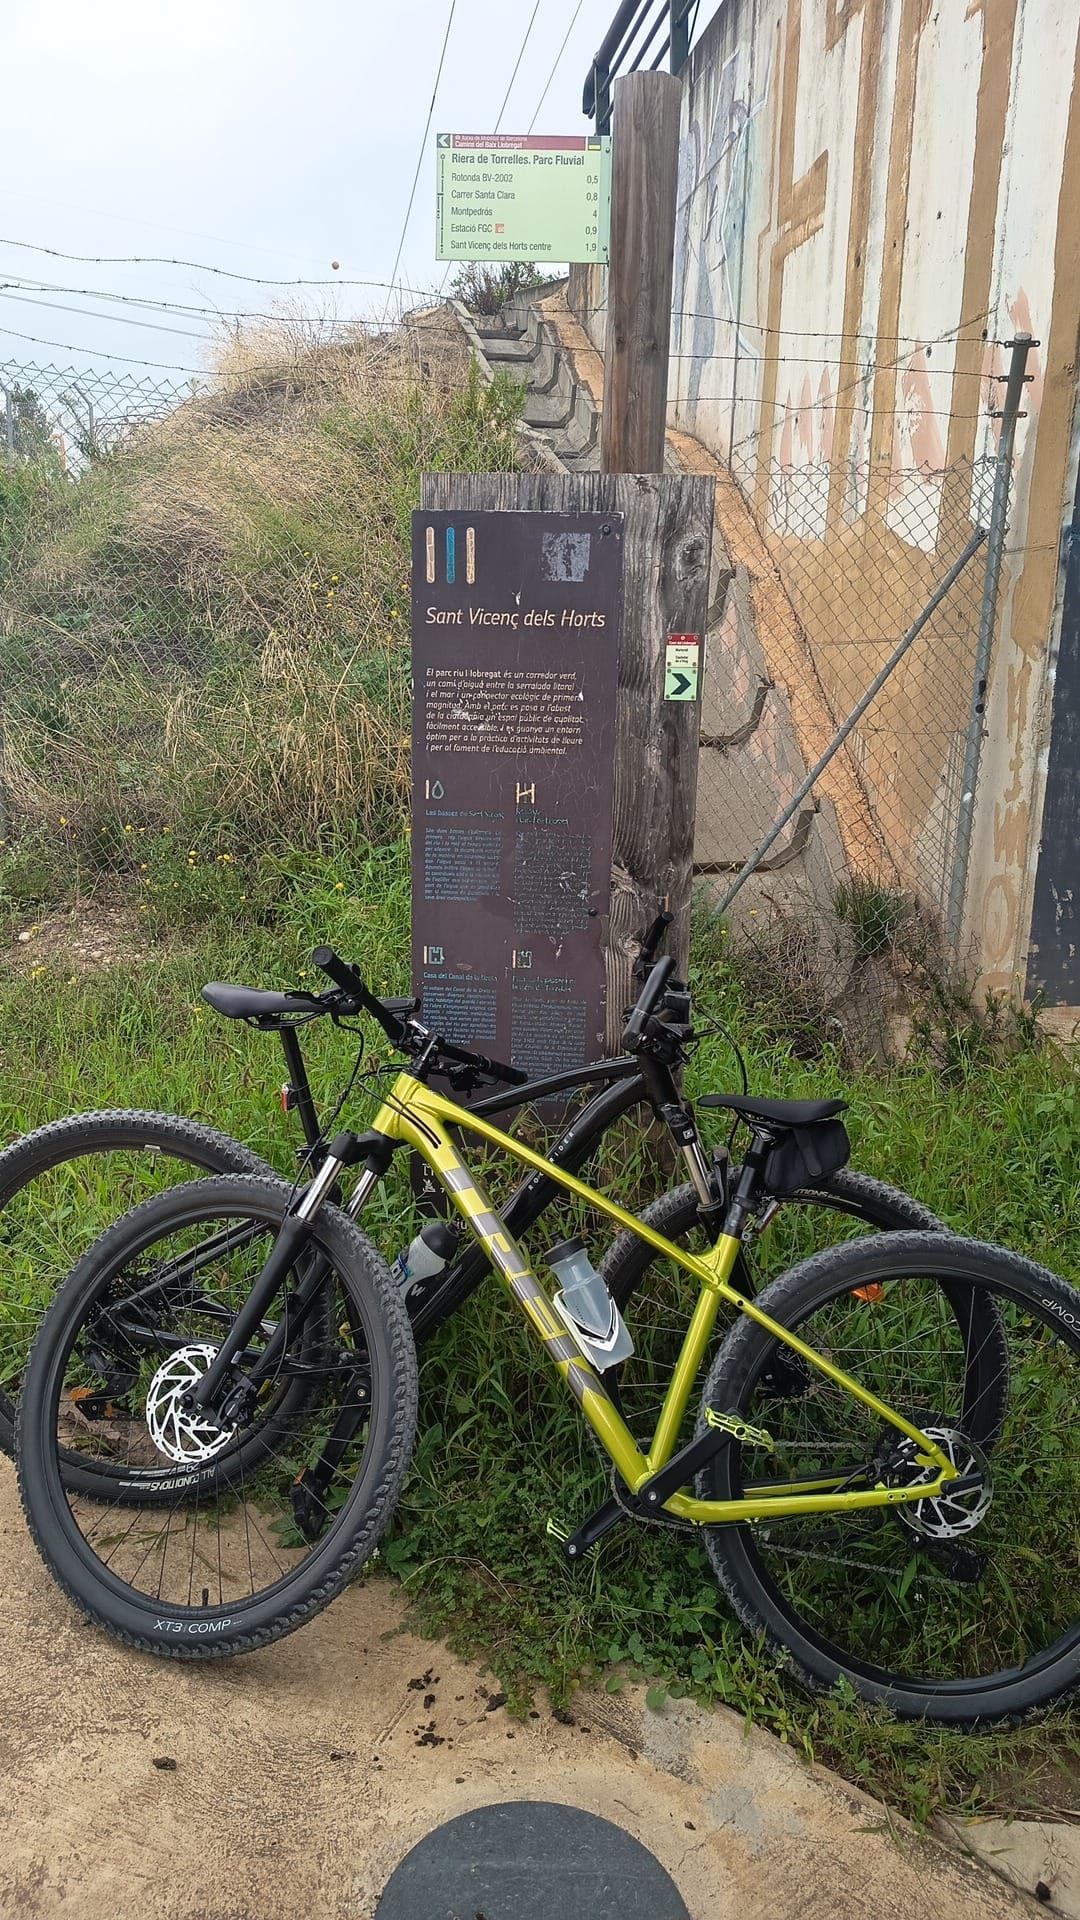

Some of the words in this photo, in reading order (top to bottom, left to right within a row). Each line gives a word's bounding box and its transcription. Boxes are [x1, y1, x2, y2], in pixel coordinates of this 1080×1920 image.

[498, 142, 523, 150] Llobregat
[452, 153, 475, 164] Riera
[477, 154, 488, 164] de
[491, 154, 531, 164] Torrelles.
[533, 155, 553, 165] Parc
[555, 155, 584, 165] Fluvial
[452, 173, 480, 182] Rotonda
[482, 173, 513, 182] BV-2002
[586, 175, 598, 185] 0,5
[451, 190, 473, 199] Carrer
[475, 190, 495, 199] Santa
[497, 190, 515, 200] Clara
[586, 192, 598, 201] 0,8
[451, 207, 493, 217] Montpedrós
[592, 210, 597, 218] 4
[451, 223, 476, 232] Estació
[478, 224, 492, 233] FGC
[585, 226, 597, 235] 0,9
[450, 240, 467, 249] Sant
[468, 241, 491, 251] Vicenç
[492, 242, 507, 250] dels
[509, 242, 528, 250] Horts
[529, 242, 552, 251] centre
[585, 243, 597, 252] 1,9
[425, 607, 463, 625] Sant
[469, 608, 520, 630] Vicenç
[523, 610, 555, 627] dels
[560, 610, 606, 628] Horts
[426, 668, 434, 676] El
[435, 670, 452, 678] parc
[453, 669, 464, 677] riu
[503, 669, 513, 678] és
[526, 671, 558, 679] corredor
[438, 679, 457, 687] camí
[486, 681, 505, 689] entre
[507, 681, 514, 689] la
[516, 682, 551, 690] serralada
[552, 682, 575, 690] litoral
[430, 690, 438, 698] el
[510, 692, 541, 701] ecològic
[541, 692, 551, 701] de
[552, 693, 583, 703] primera
[464, 701, 481, 710] Amb
[483, 702, 490, 710] el
[492, 704, 508, 712] parc
[520, 705, 538, 713] posa
[547, 703, 571, 712] l'abast
[426, 711, 436, 719] de
[437, 711, 444, 719] la
[498, 713, 518, 722] espai
[519, 713, 541, 722] públic
[543, 714, 552, 722] de
[426, 721, 460, 730] fàcilment
[517, 726, 543, 734] guanya
[556, 726, 581, 734] entorn
[426, 732, 447, 741] òptim
[470, 733, 477, 741] la
[479, 733, 508, 743] pràctica
[510, 735, 549, 744] d'activitats
[550, 736, 560, 744] de
[562, 736, 583, 744] lleure
[453, 743, 480, 752] foment
[481, 744, 491, 752] de
[492, 744, 527, 753] l'educació
[527, 1131, 574, 1191] ROCRIDER
[441, 1145, 605, 1403] TREK
[201, 1466, 216, 1479] ALL
[153, 1619, 183, 1633] XT3
[188, 1619, 231, 1634] COMP
